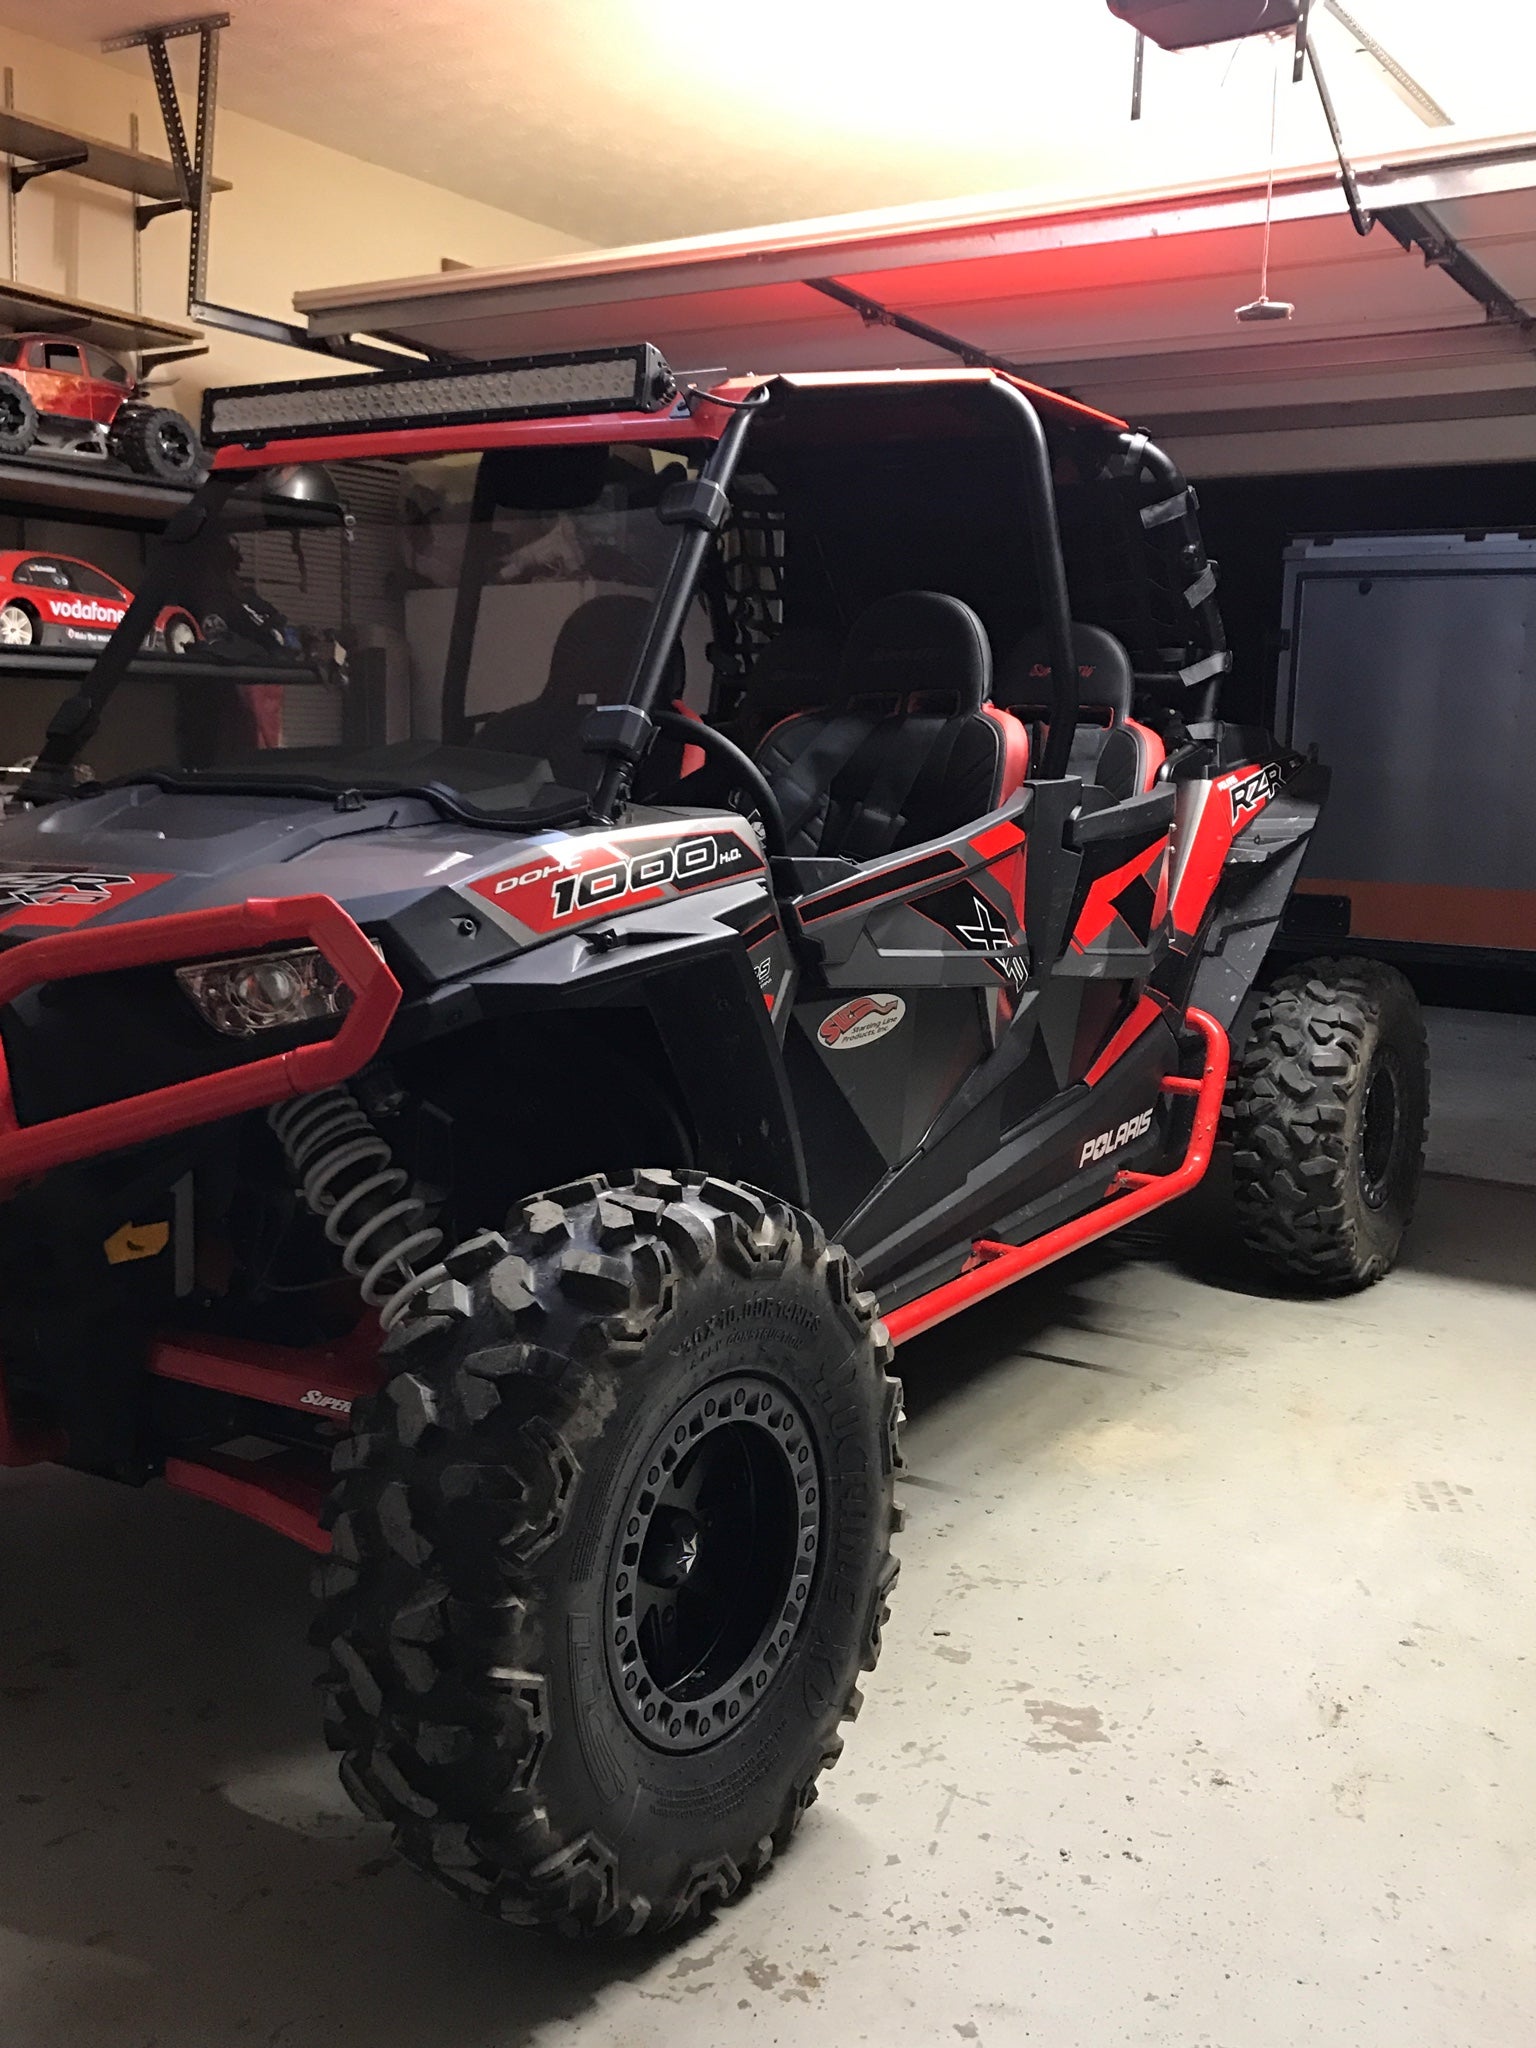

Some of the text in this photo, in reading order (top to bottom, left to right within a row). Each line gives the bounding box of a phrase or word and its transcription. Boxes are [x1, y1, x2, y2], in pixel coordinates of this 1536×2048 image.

[49, 600, 125, 622] vodafone
[1229, 762, 1287, 827] RZR
[551, 836, 718, 920] 1000
[851, 1016, 898, 1034] Starting Line
[1079, 1107, 1154, 1169] POLARIS
